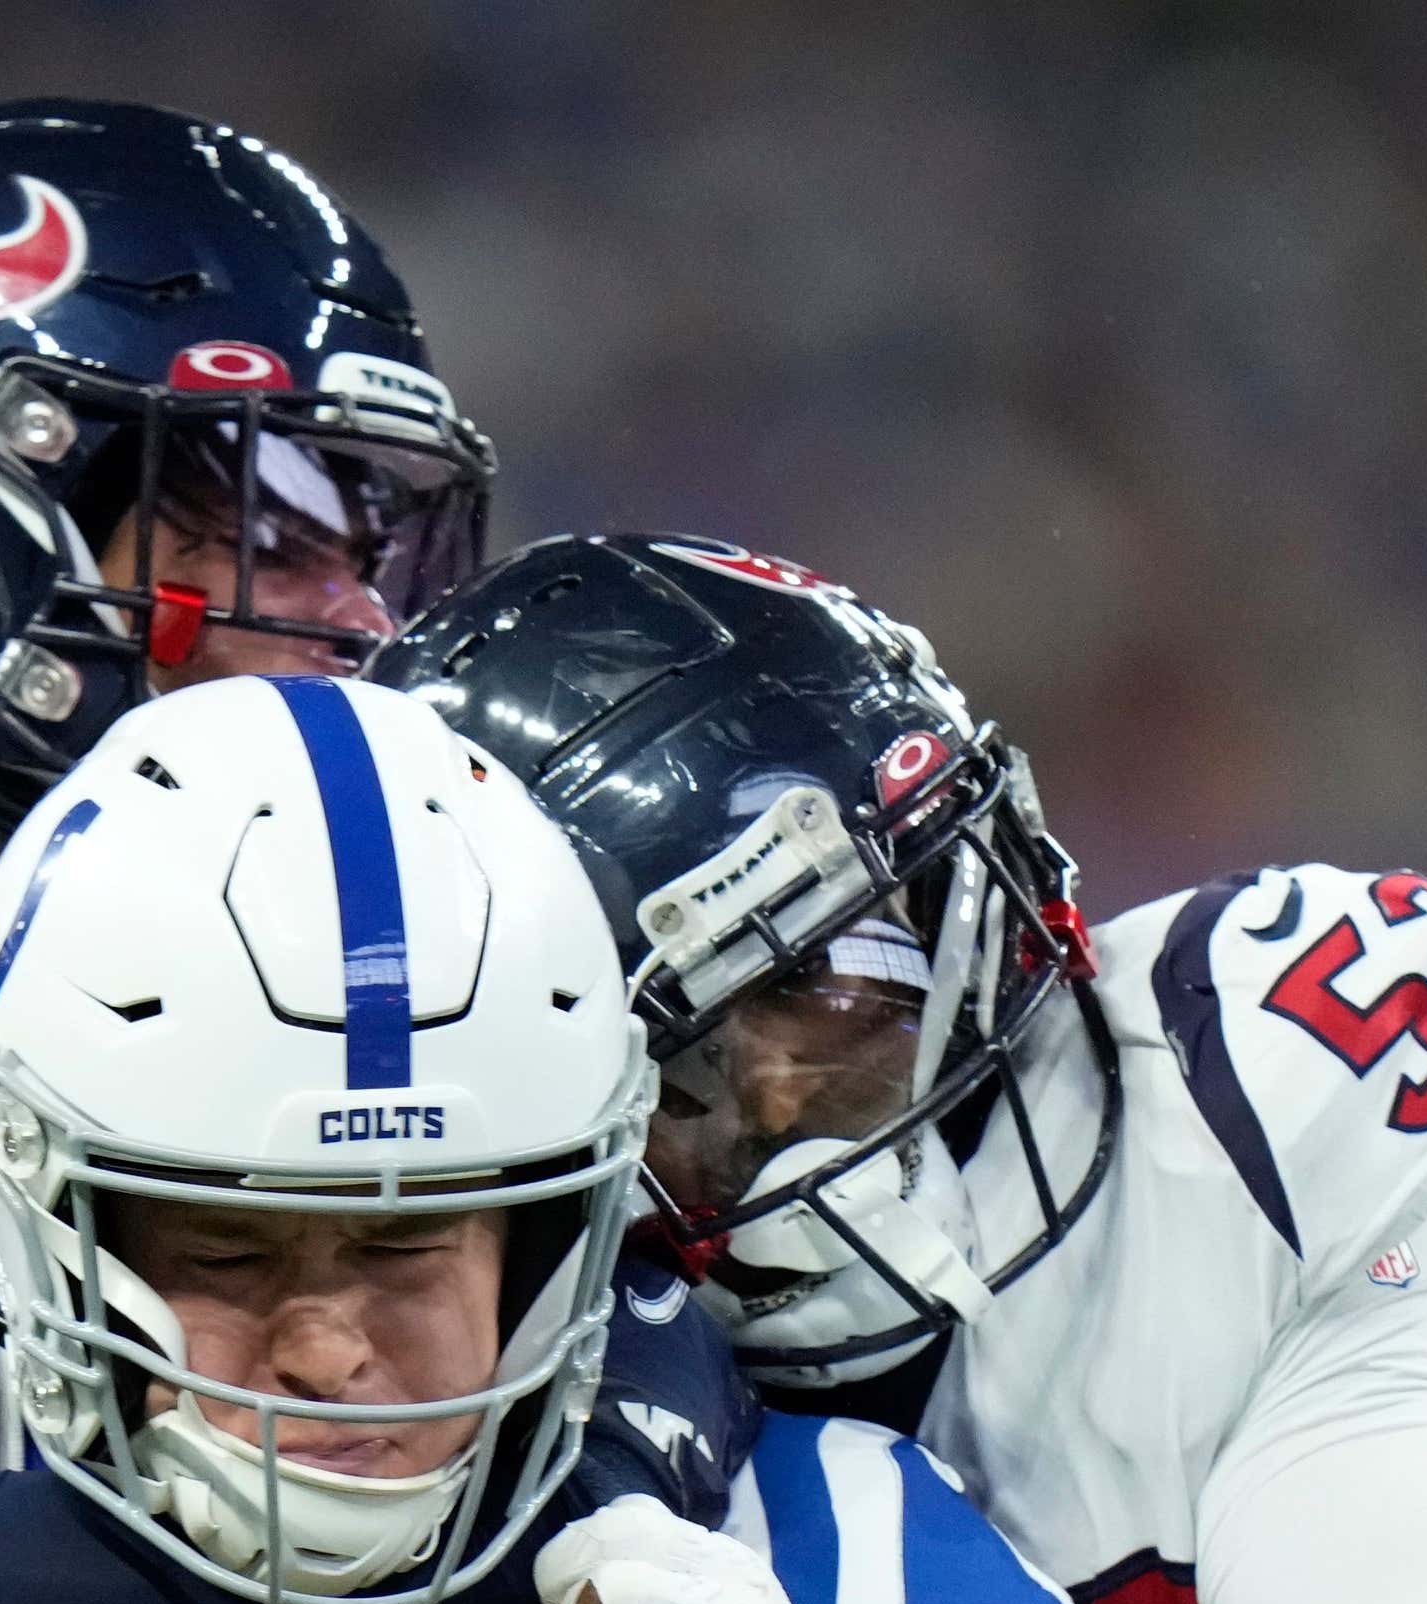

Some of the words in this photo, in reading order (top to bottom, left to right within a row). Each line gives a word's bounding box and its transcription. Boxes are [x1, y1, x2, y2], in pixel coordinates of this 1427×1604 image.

[690, 832, 784, 903] TEXANS
[320, 1105, 444, 1144] COLTS
[1371, 1245, 1415, 1279] NFL
